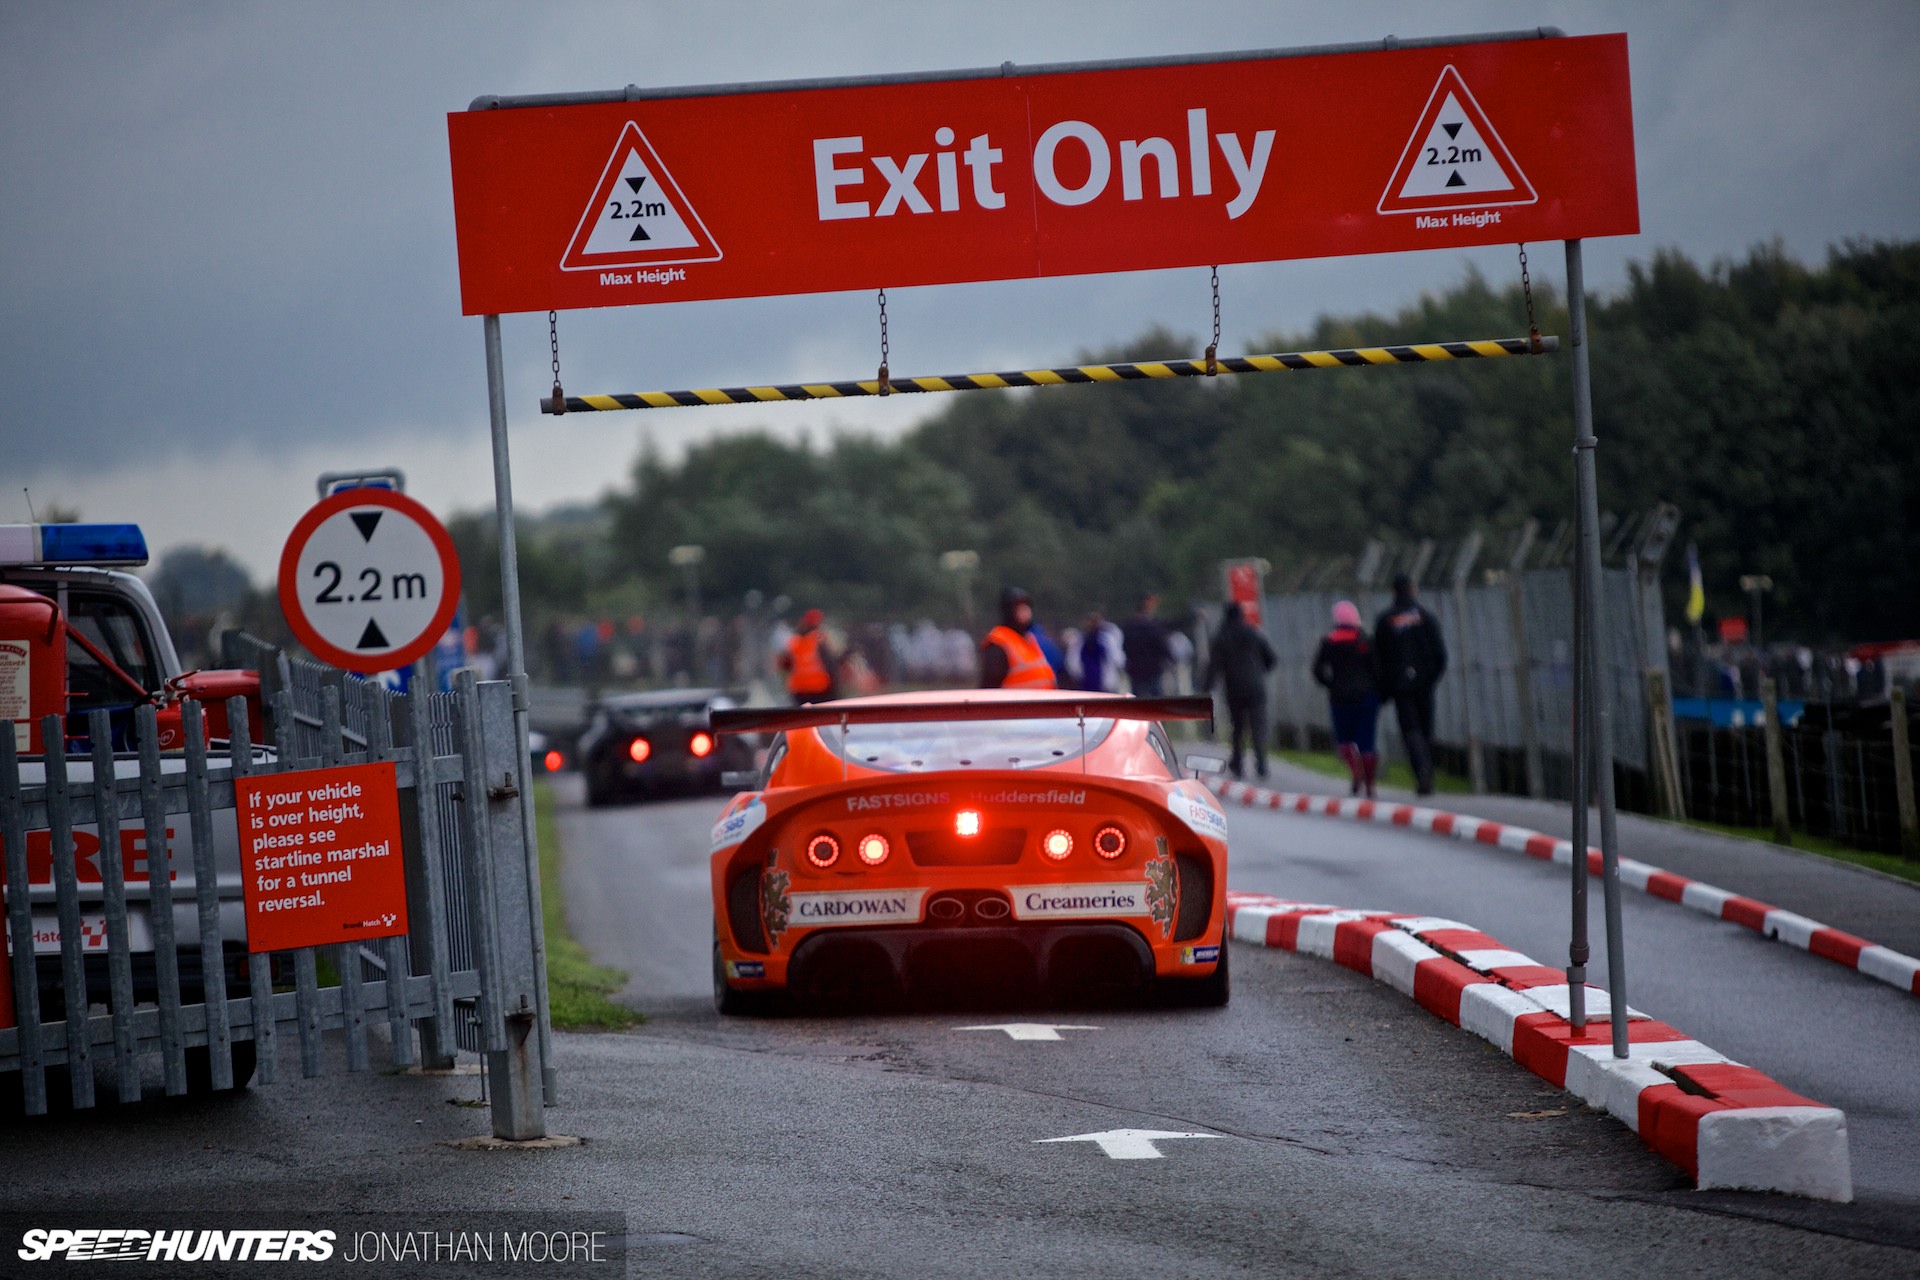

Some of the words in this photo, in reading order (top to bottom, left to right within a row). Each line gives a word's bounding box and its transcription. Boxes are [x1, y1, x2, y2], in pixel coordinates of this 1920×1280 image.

[813, 127, 1006, 221] Exit
[1033, 107, 1277, 220] Only
[1427, 146, 1482, 165] 2.2m
[610, 200, 666, 219] 2.2m
[1416, 216, 1448, 229] Max
[1452, 210, 1501, 228] Height
[600, 272, 632, 286] Max
[637, 268, 686, 285] Height
[249, 791, 261, 808] If
[266, 790, 302, 810] your
[307, 781, 361, 801] vehicle
[847, 792, 950, 811] FASTSIGNS
[970, 791, 1086, 805] Huddersfield
[251, 813, 264, 829] is
[269, 812, 304, 827] over
[308, 803, 364, 823] height,
[253, 833, 304, 853] please
[309, 830, 336, 844] see
[0, 827, 177, 885] RE
[255, 849, 322, 871] startline
[327, 840, 390, 862] marshal
[257, 875, 281, 891] for
[286, 876, 296, 888] a
[300, 865, 351, 887] tunnel
[258, 890, 325, 912] reversal.
[800, 899, 907, 916] CARDOWAN
[1026, 890, 1135, 911] Creameries
